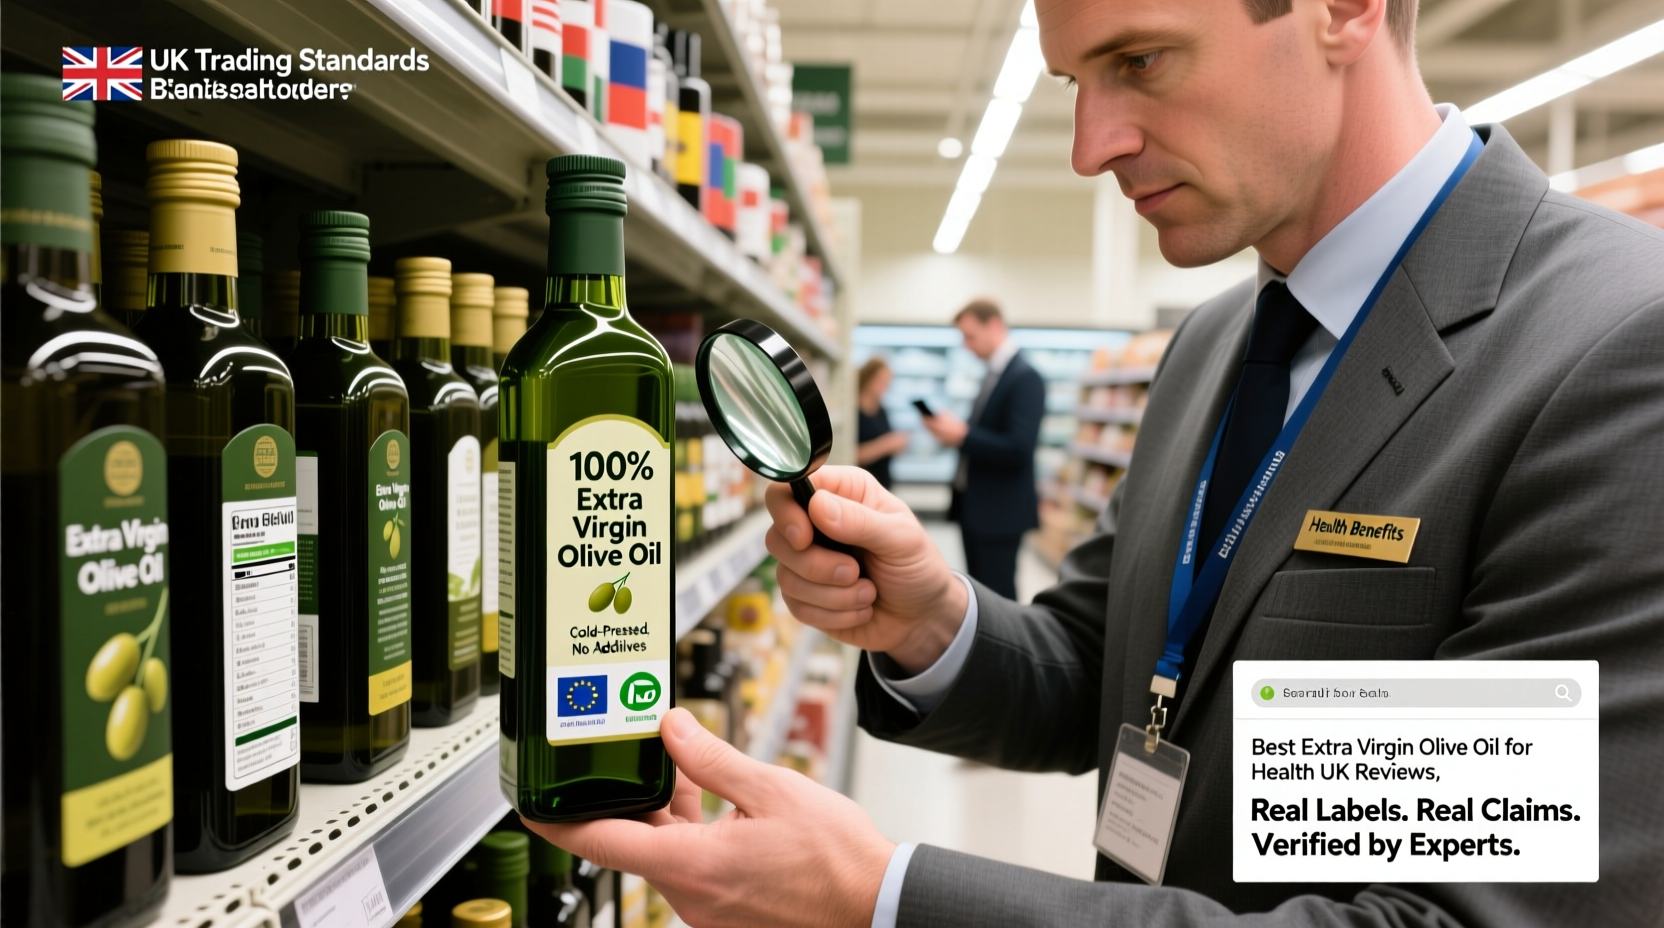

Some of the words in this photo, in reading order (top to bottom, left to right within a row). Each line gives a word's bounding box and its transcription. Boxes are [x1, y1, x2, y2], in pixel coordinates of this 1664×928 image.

[569, 450, 654, 481] 100%
[577, 487, 643, 511] Extra
[572, 514, 647, 545] Virgin
[1308, 516, 1348, 536] Health
[1349, 520, 1405, 542] Benefits
[557, 543, 623, 568] Olive
[628, 541, 662, 566] Oil
[572, 642, 590, 656] No
